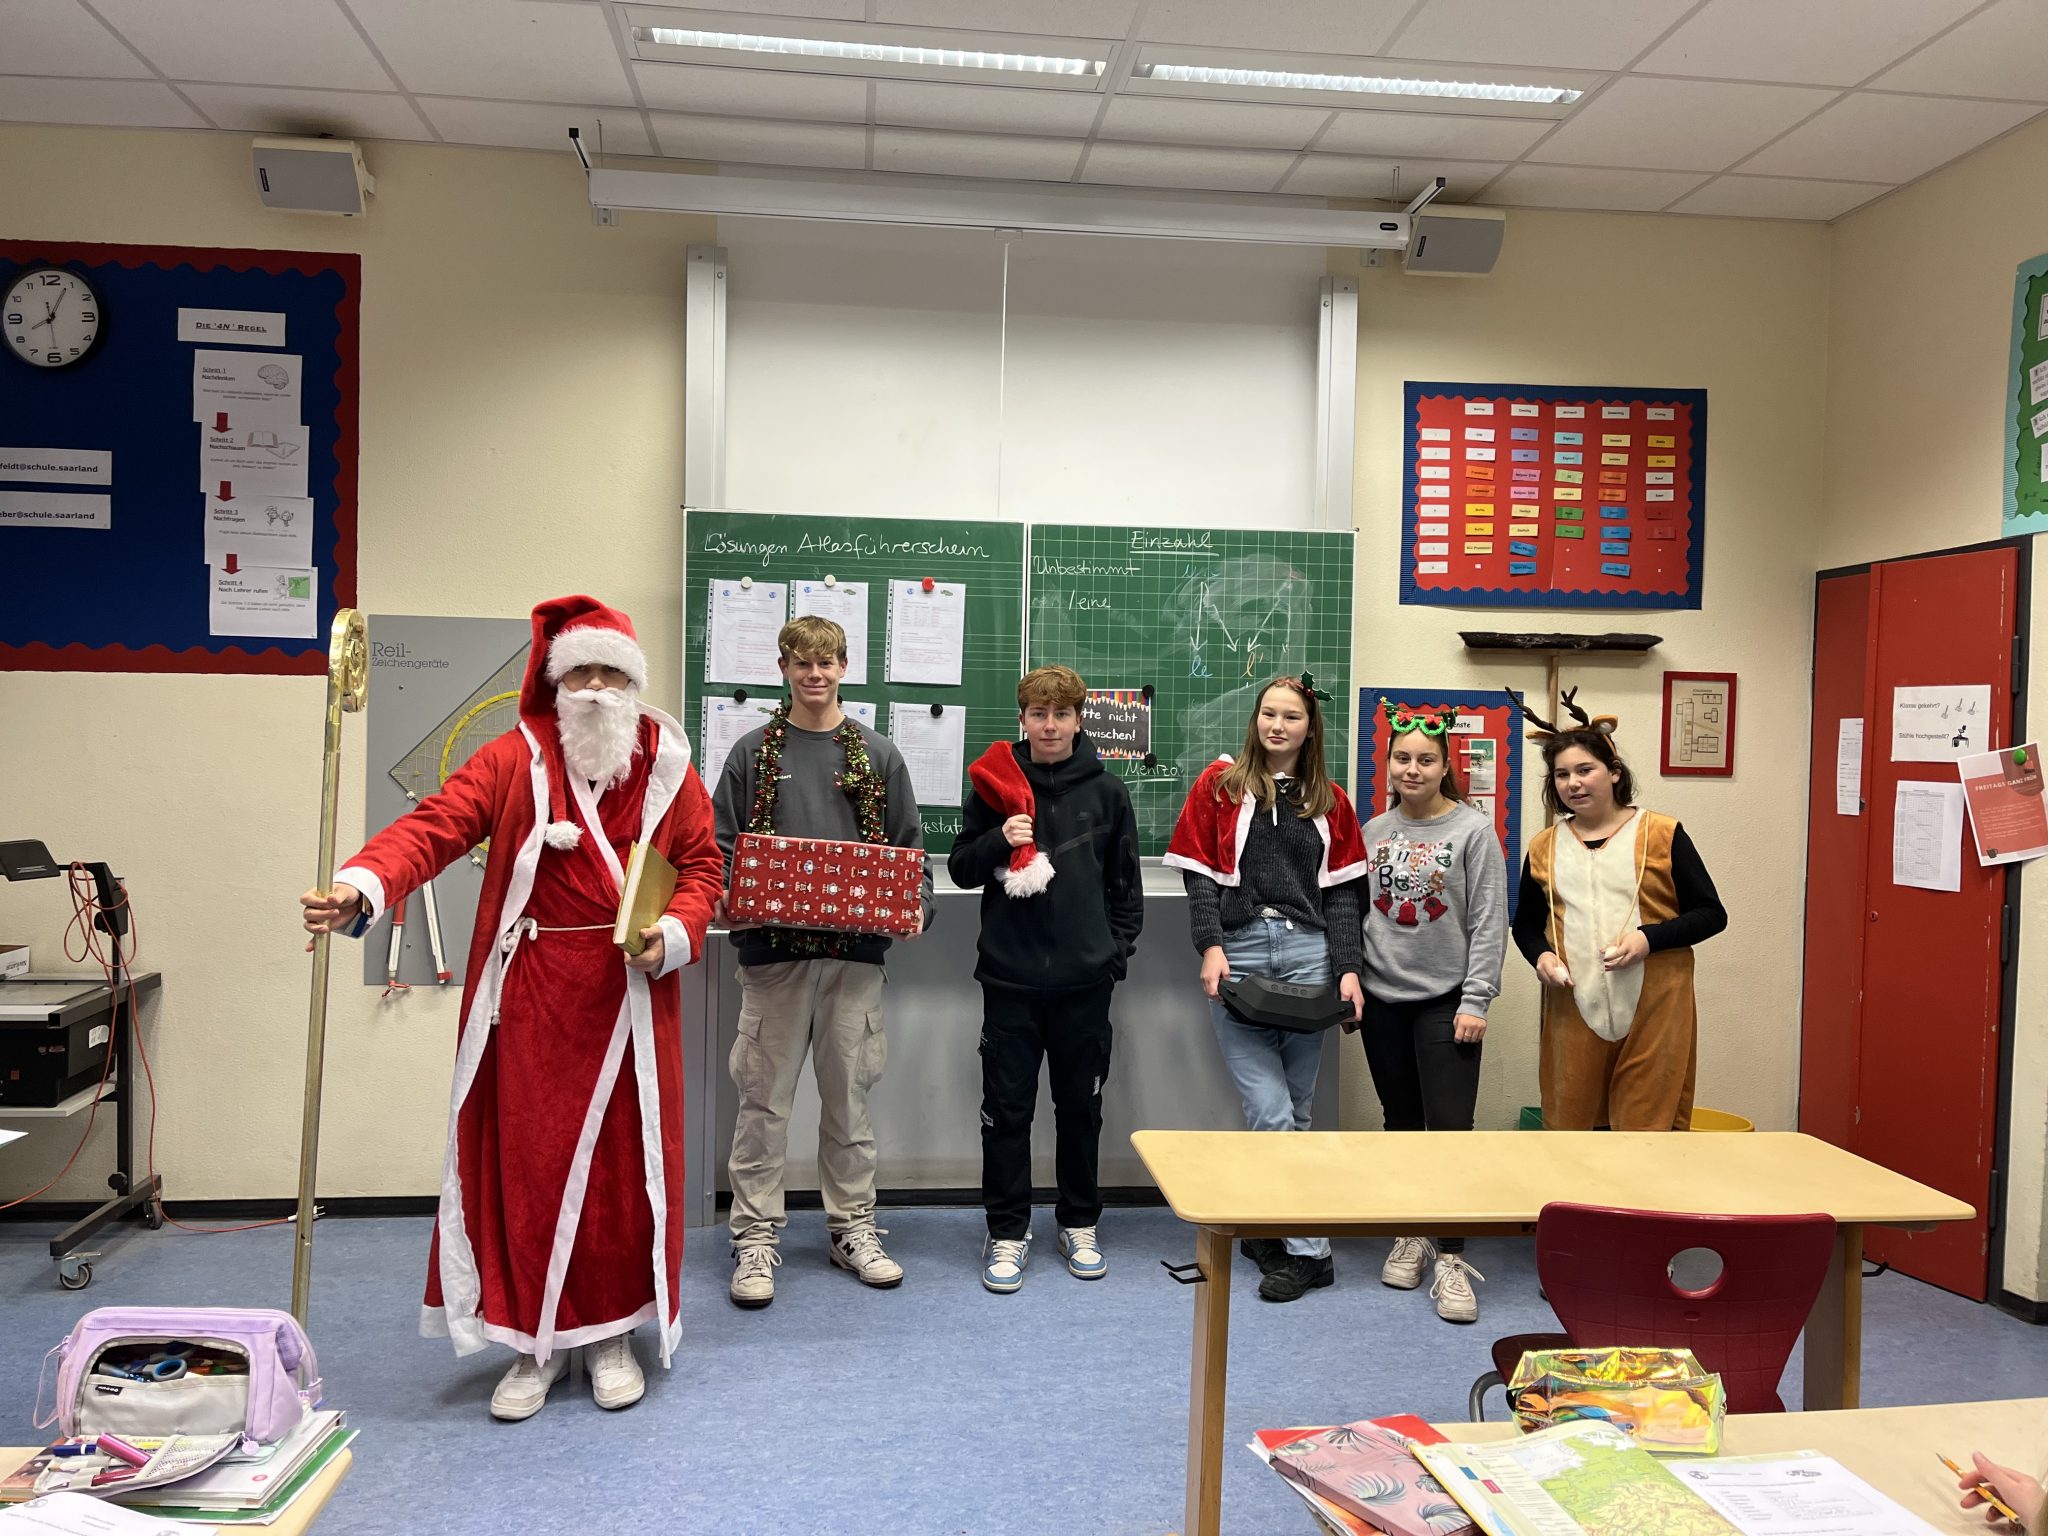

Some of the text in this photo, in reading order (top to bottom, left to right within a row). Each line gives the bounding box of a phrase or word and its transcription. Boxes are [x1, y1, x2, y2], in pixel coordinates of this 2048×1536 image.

[40, 275, 61, 286] 12
[8, 313, 23, 324] 9
[82, 312, 96, 323] 3
[47, 352, 62, 363] 6
[1131, 530, 1214, 549] Einzahl
[704, 531, 788, 567] Lösungen
[1032, 556, 1141, 576] Unbestimmt
[372, 641, 411, 657] Reil-
[372, 657, 449, 669] Zeichengeräte
[1109, 711, 1138, 722] nicht
[1975, 782, 2006, 791] FREITAGS
[2007, 778, 2023, 786] GANZ
